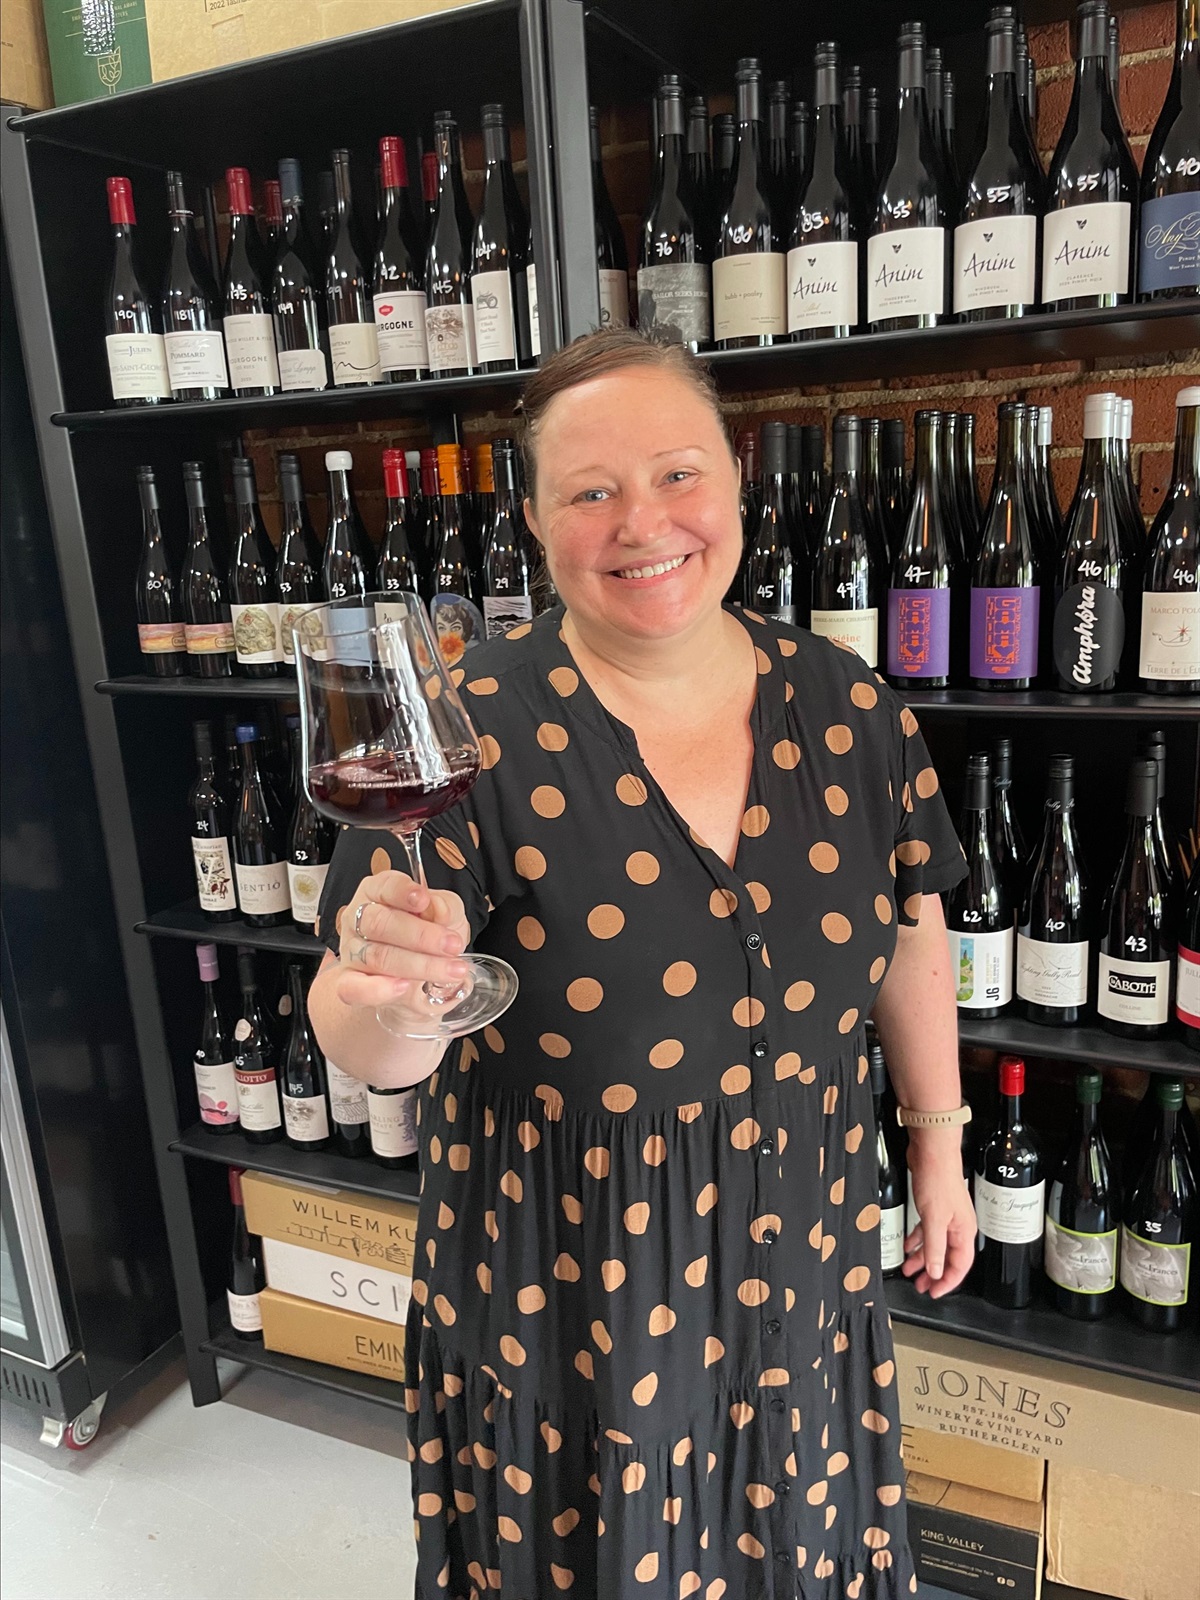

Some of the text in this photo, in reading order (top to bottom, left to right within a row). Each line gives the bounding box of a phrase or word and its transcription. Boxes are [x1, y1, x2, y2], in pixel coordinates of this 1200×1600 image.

[1077, 173, 1100, 192] 55
[986, 186, 1011, 203] 55
[893, 206, 911, 219] 55
[802, 212, 824, 233] 85
[475, 244, 492, 260] 104
[655, 241, 673, 257] 76
[1054, 240, 1110, 266] Anim
[380, 265, 400, 280] 92
[963, 253, 1016, 277] Anim
[874, 264, 924, 288] Anim
[328, 285, 343, 300] 99
[432, 280, 453, 294] 145
[793, 276, 838, 300] Anim
[115, 310, 134, 321] 190
[278, 302, 294, 314] 149
[128, 346, 152, 357] JULIEN
[170, 352, 206, 360] POMMARD
[904, 564, 931, 583] 47
[1077, 559, 1103, 577] 46
[386, 578, 400, 590] 33
[440, 574, 452, 586] 33
[495, 577, 509, 589] 29
[1173, 568, 1195, 586] 46
[331, 582, 347, 597] 43
[756, 584, 774, 598] 45
[836, 582, 859, 599] 47
[1150, 607, 1180, 615] MARCO
[196, 820, 209, 832] 24
[295, 850, 309, 860] 52
[1045, 918, 1065, 932] 40
[1125, 935, 1148, 952] 43
[997, 1165, 1018, 1179] 92
[292, 1198, 381, 1233] WILLEM
[1145, 1221, 1162, 1233] 35
[914, 1365, 1072, 1429] JONES
[962, 1404, 1017, 1423] EST. 1860
[915, 1402, 1064, 1447] WINERY & VINEYARD
[939, 1422, 1041, 1455] RUTHERGLEN
[920, 1528, 984, 1552] KING VALLEY
